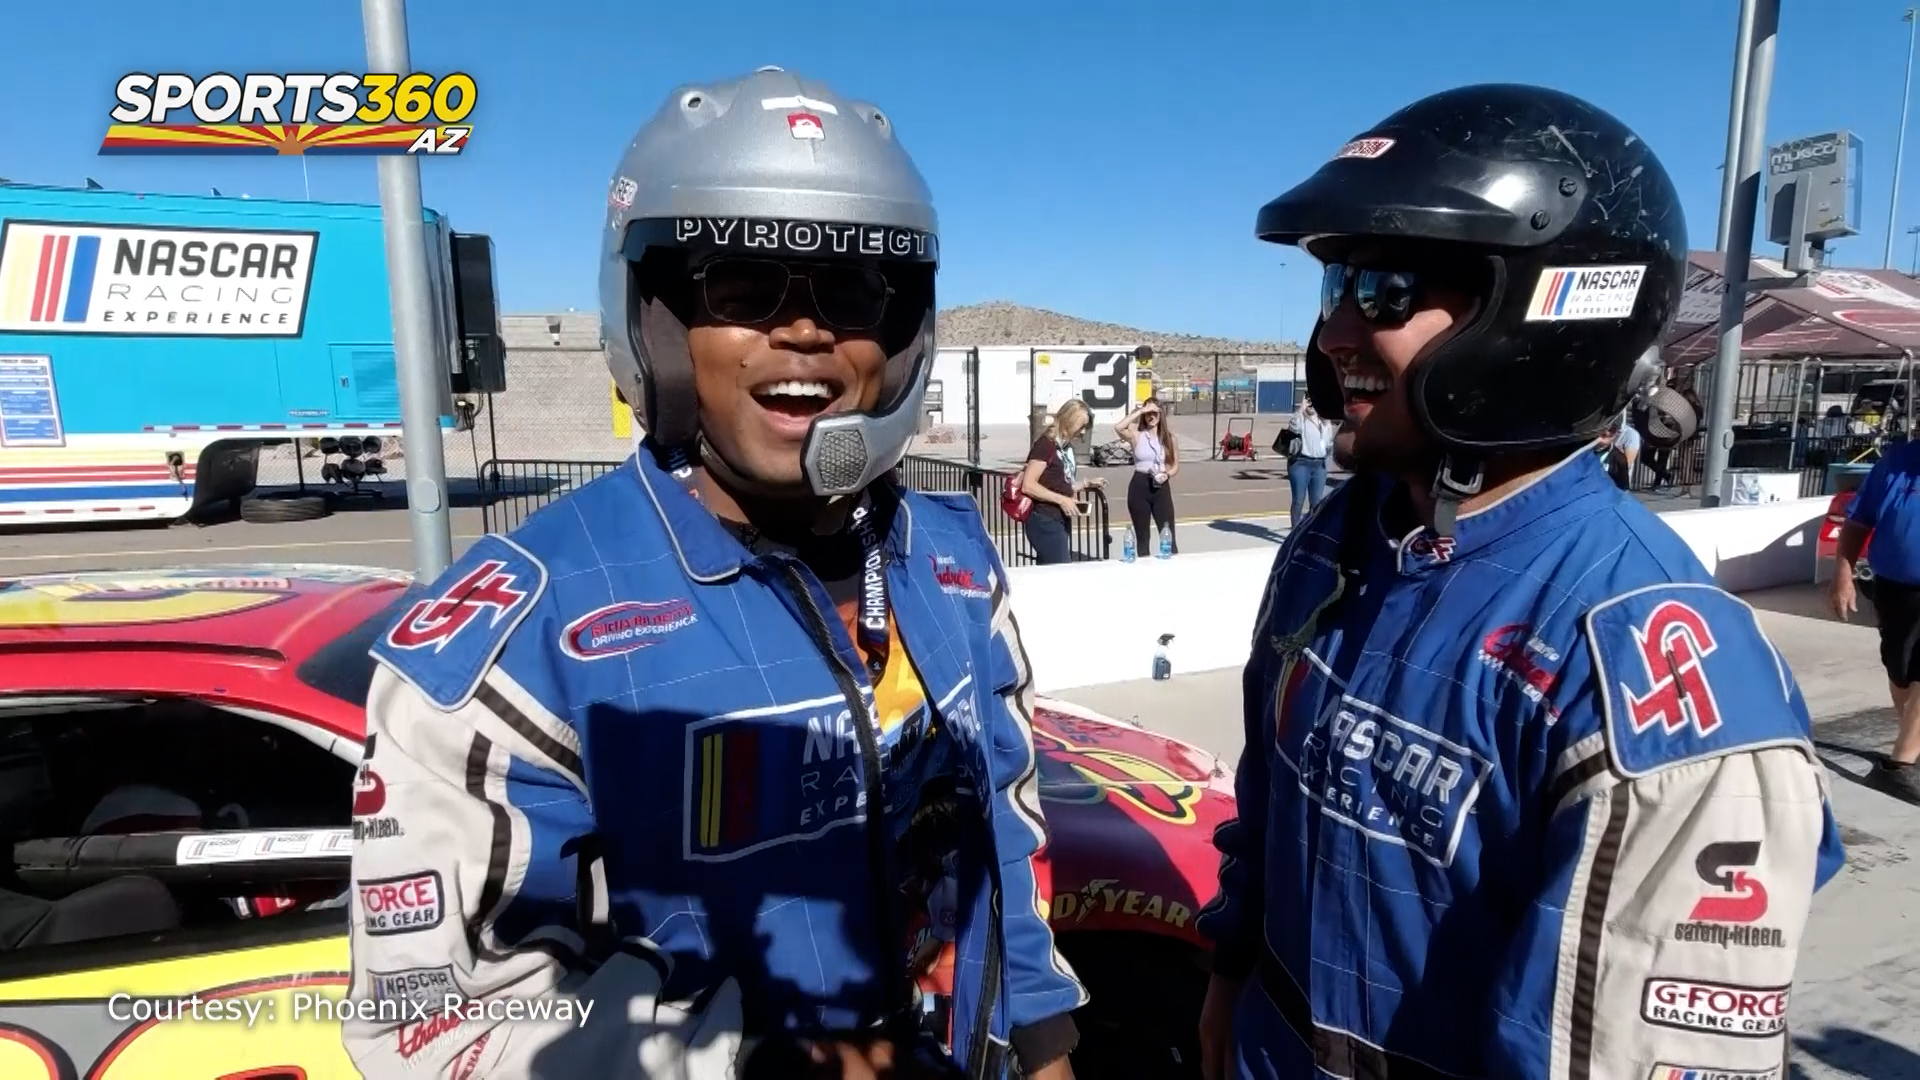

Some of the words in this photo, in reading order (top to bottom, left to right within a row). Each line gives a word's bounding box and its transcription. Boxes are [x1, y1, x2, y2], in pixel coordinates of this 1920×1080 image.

[676, 217, 926, 255] PYROTECT
[113, 238, 299, 279] NASCAR
[1576, 269, 1641, 291] NASCAR
[107, 283, 293, 304] RACING
[103, 310, 289, 324] EXPERIENCE
[1081, 352, 1131, 409] 3
[392, 908, 435, 927] GEAR
[385, 970, 452, 996] NASCAR
[1654, 983, 1787, 1018] G-FORCE
[1653, 1005, 1735, 1030] RACING
[1742, 1016, 1785, 1032] GEAR
